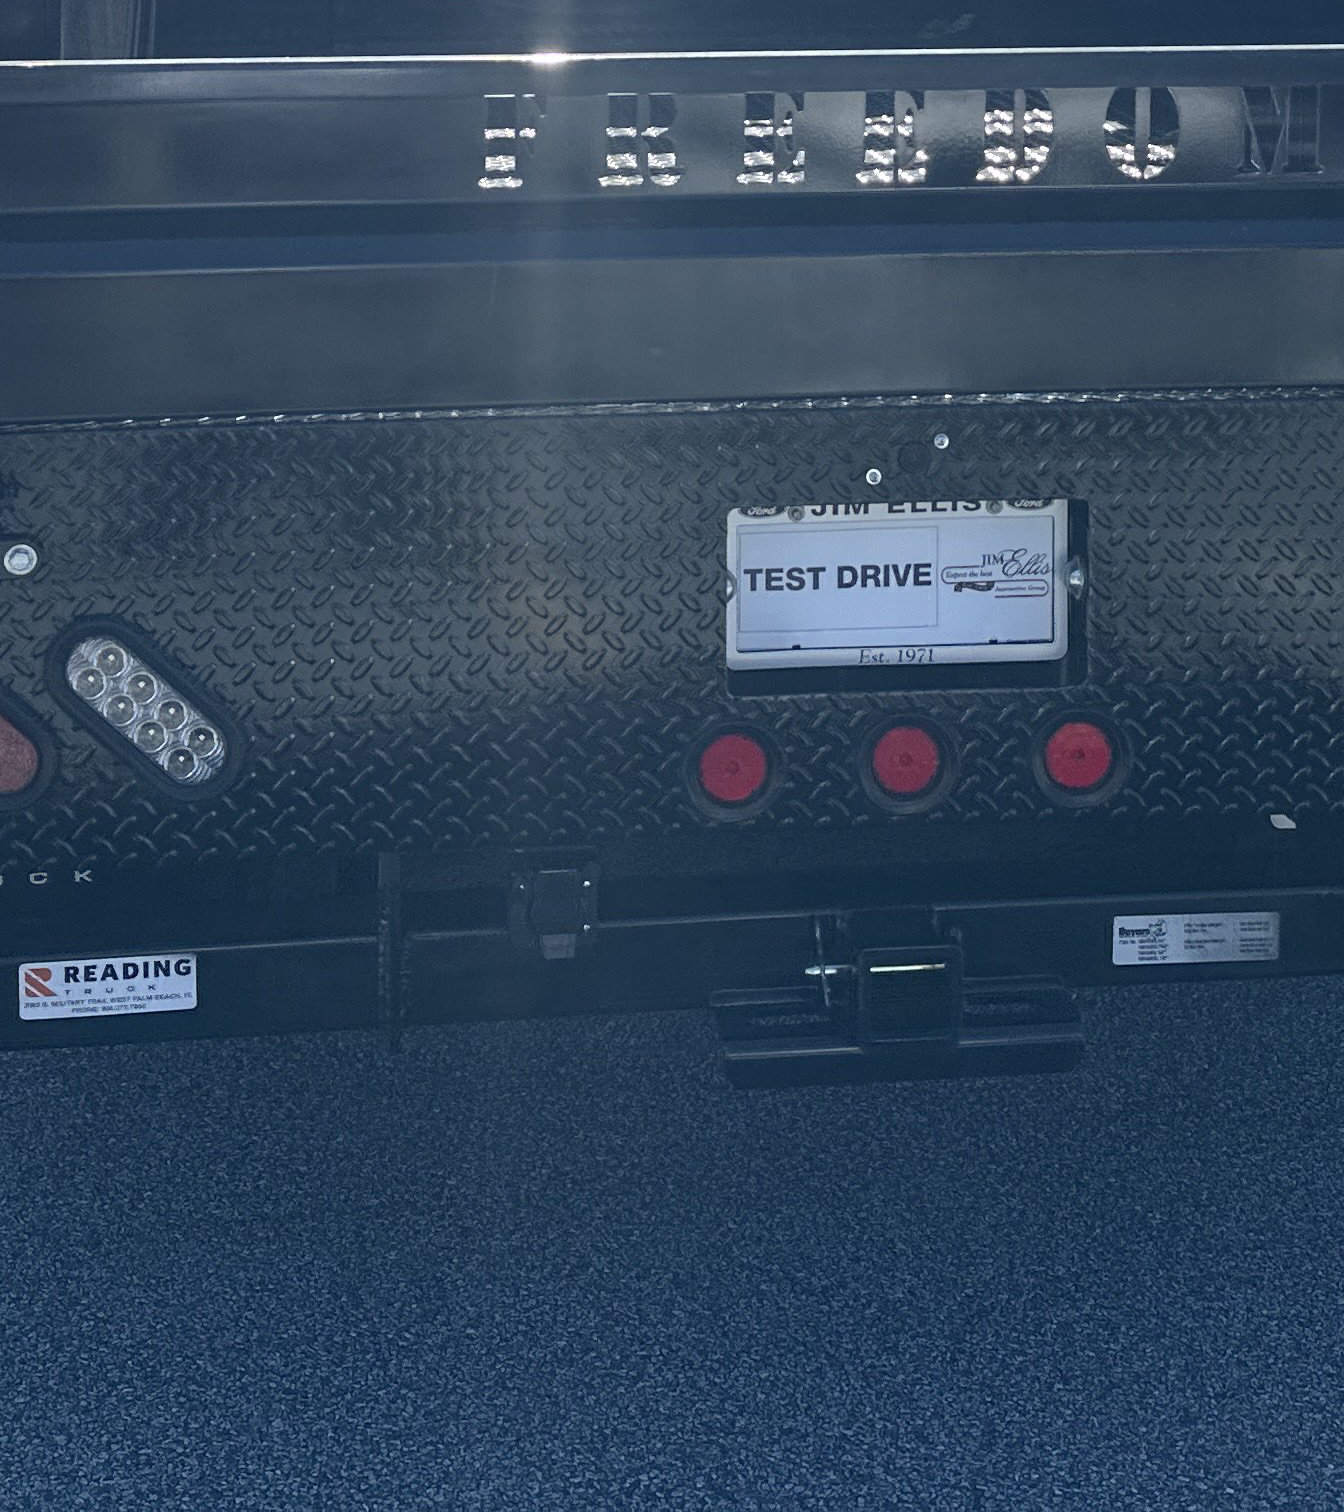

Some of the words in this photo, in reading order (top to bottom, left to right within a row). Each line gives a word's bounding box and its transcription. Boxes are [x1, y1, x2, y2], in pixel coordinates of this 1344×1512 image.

[478, 84, 1324, 189] FREEDOM
[981, 553, 1004, 567] JIM
[999, 548, 1052, 578] Ellis
[743, 565, 826, 592] TEST
[837, 563, 933, 589] DRIVE
[859, 648, 891, 664] Est.
[897, 648, 935, 663] 1971
[64, 958, 192, 984] READING
[65, 984, 157, 995] TRUCK
